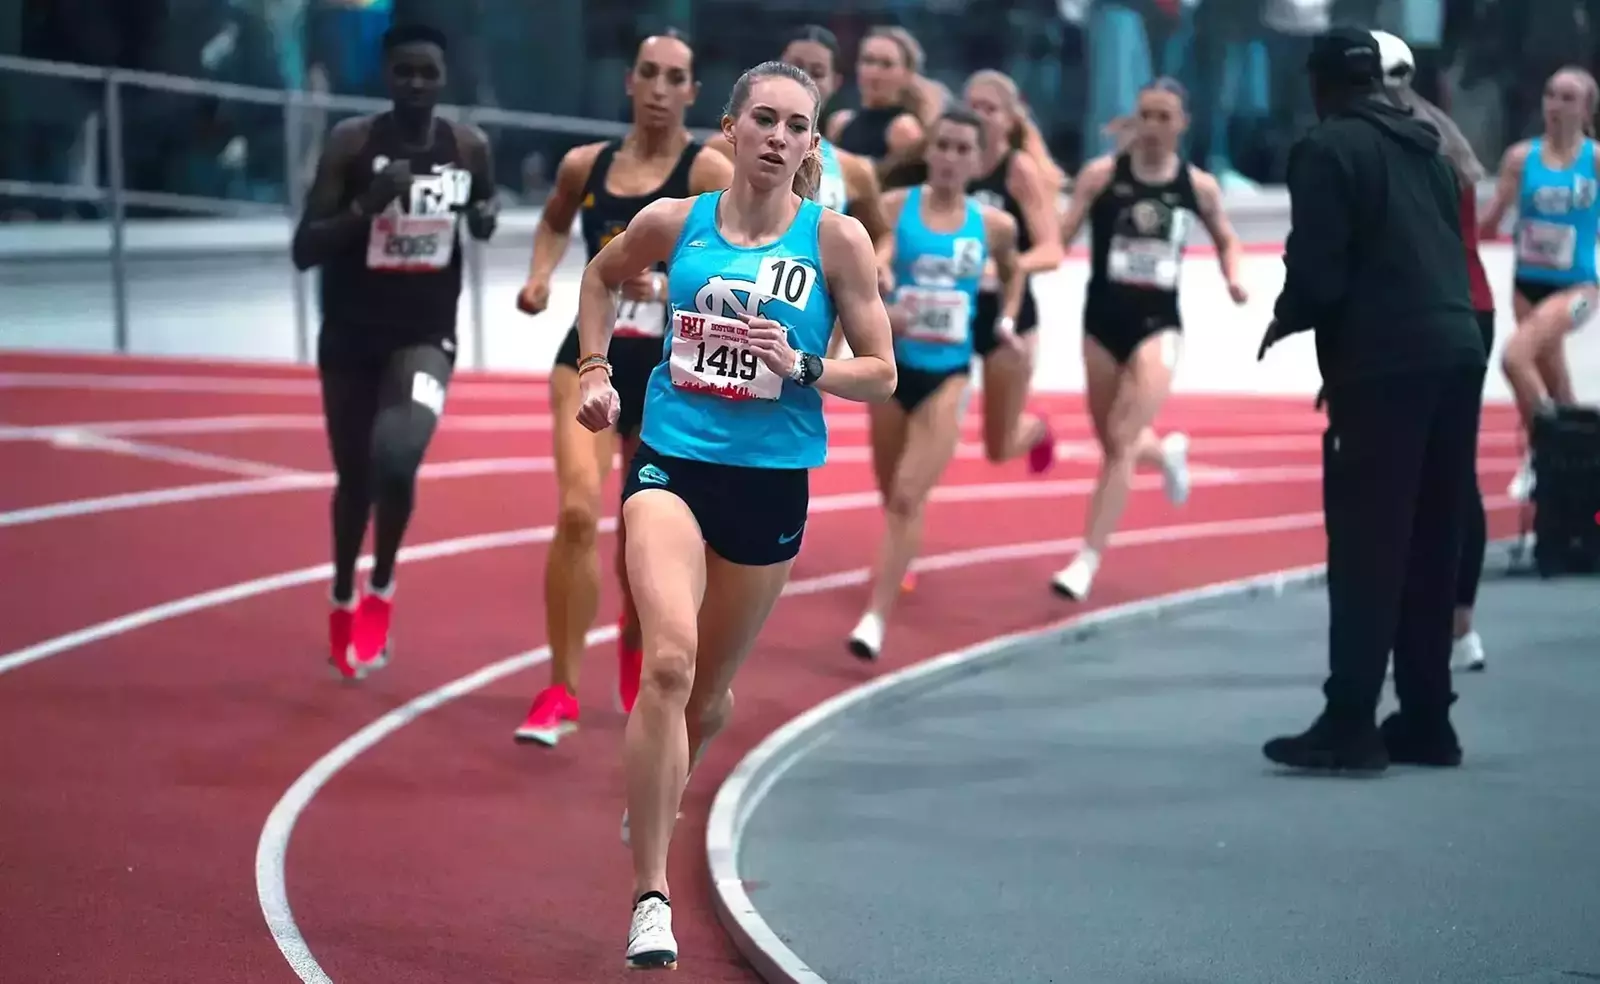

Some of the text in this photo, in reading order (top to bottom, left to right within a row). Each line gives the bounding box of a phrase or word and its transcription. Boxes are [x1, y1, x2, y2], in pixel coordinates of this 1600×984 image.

[770, 260, 807, 303] 10
[680, 315, 706, 337] BU
[693, 341, 758, 381] 1419
